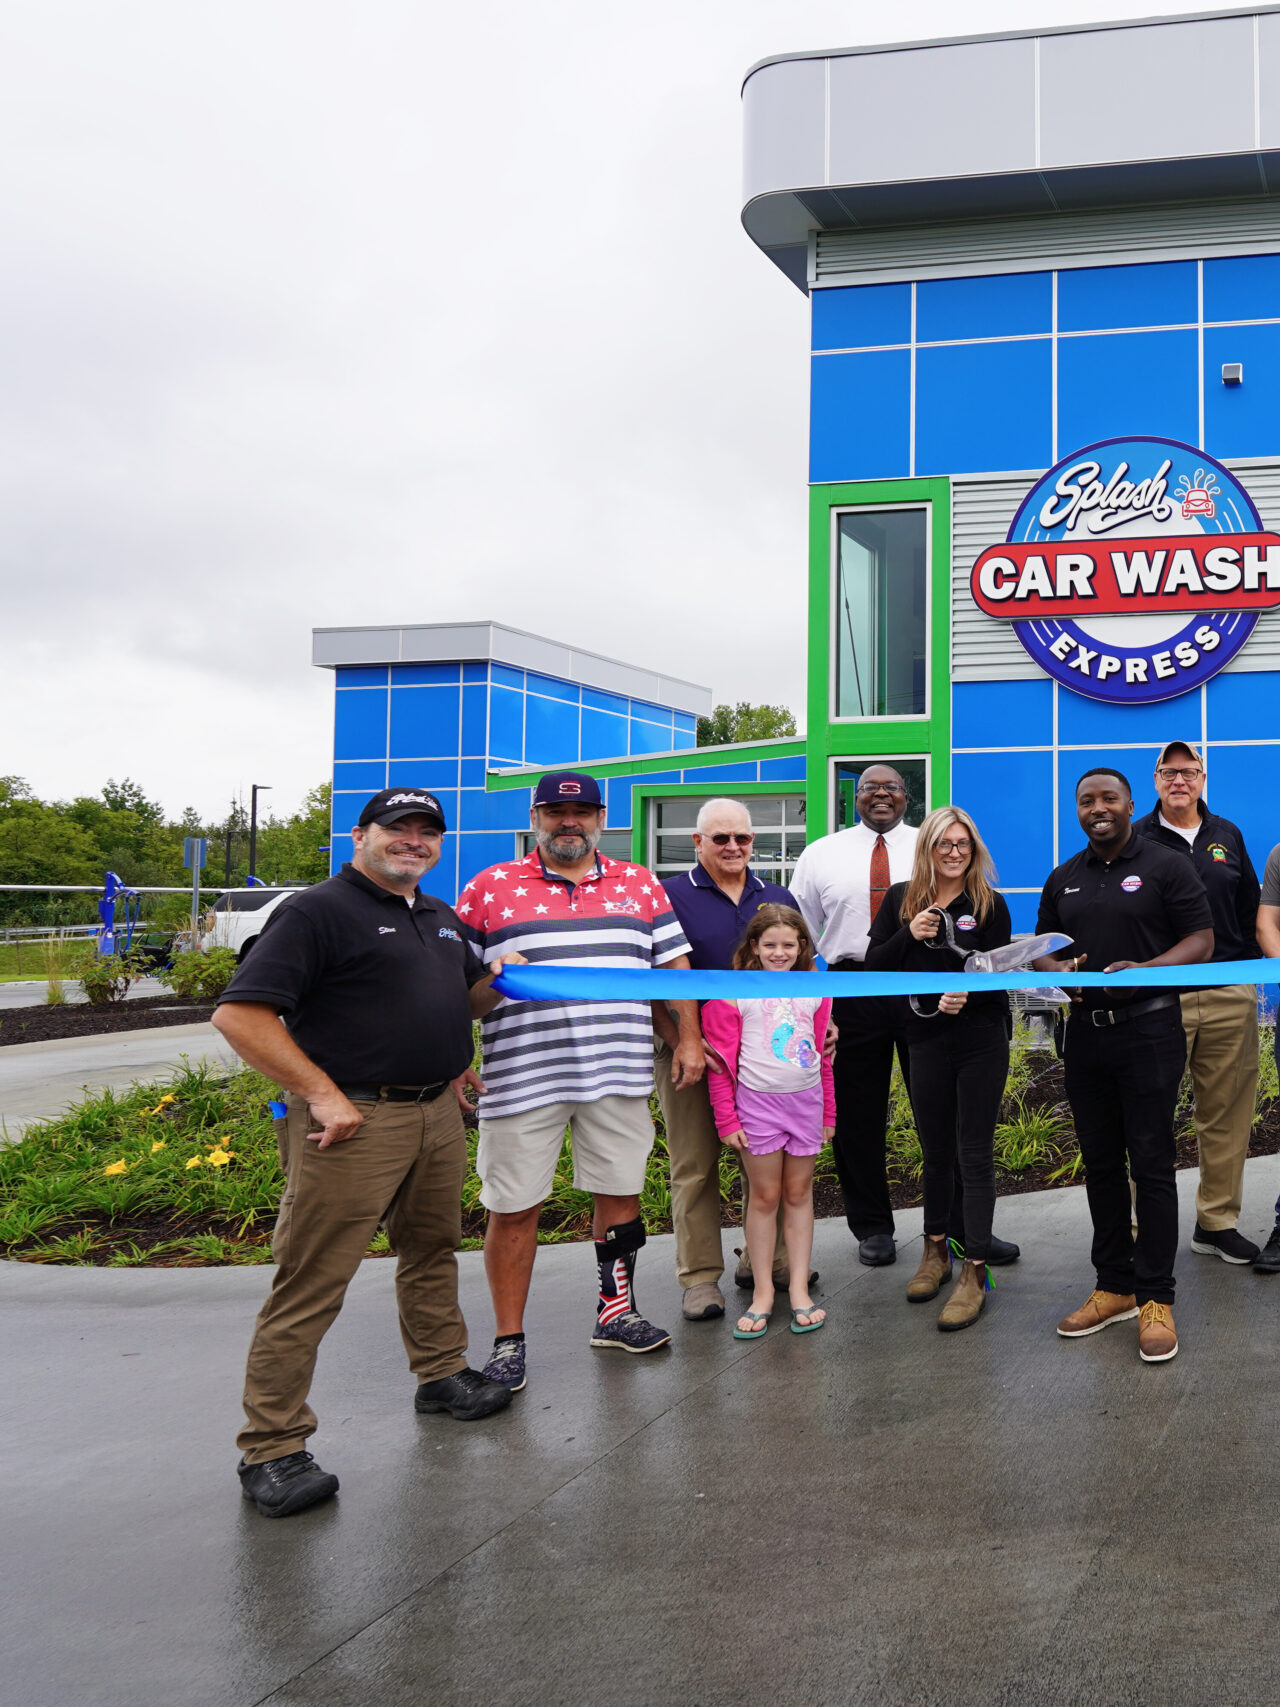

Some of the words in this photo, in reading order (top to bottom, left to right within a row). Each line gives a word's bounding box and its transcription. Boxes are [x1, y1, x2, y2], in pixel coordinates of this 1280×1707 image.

[1039, 459, 1172, 534] Splash
[978, 554, 1096, 601] CAR
[1048, 625, 1221, 684] EXPRESS
